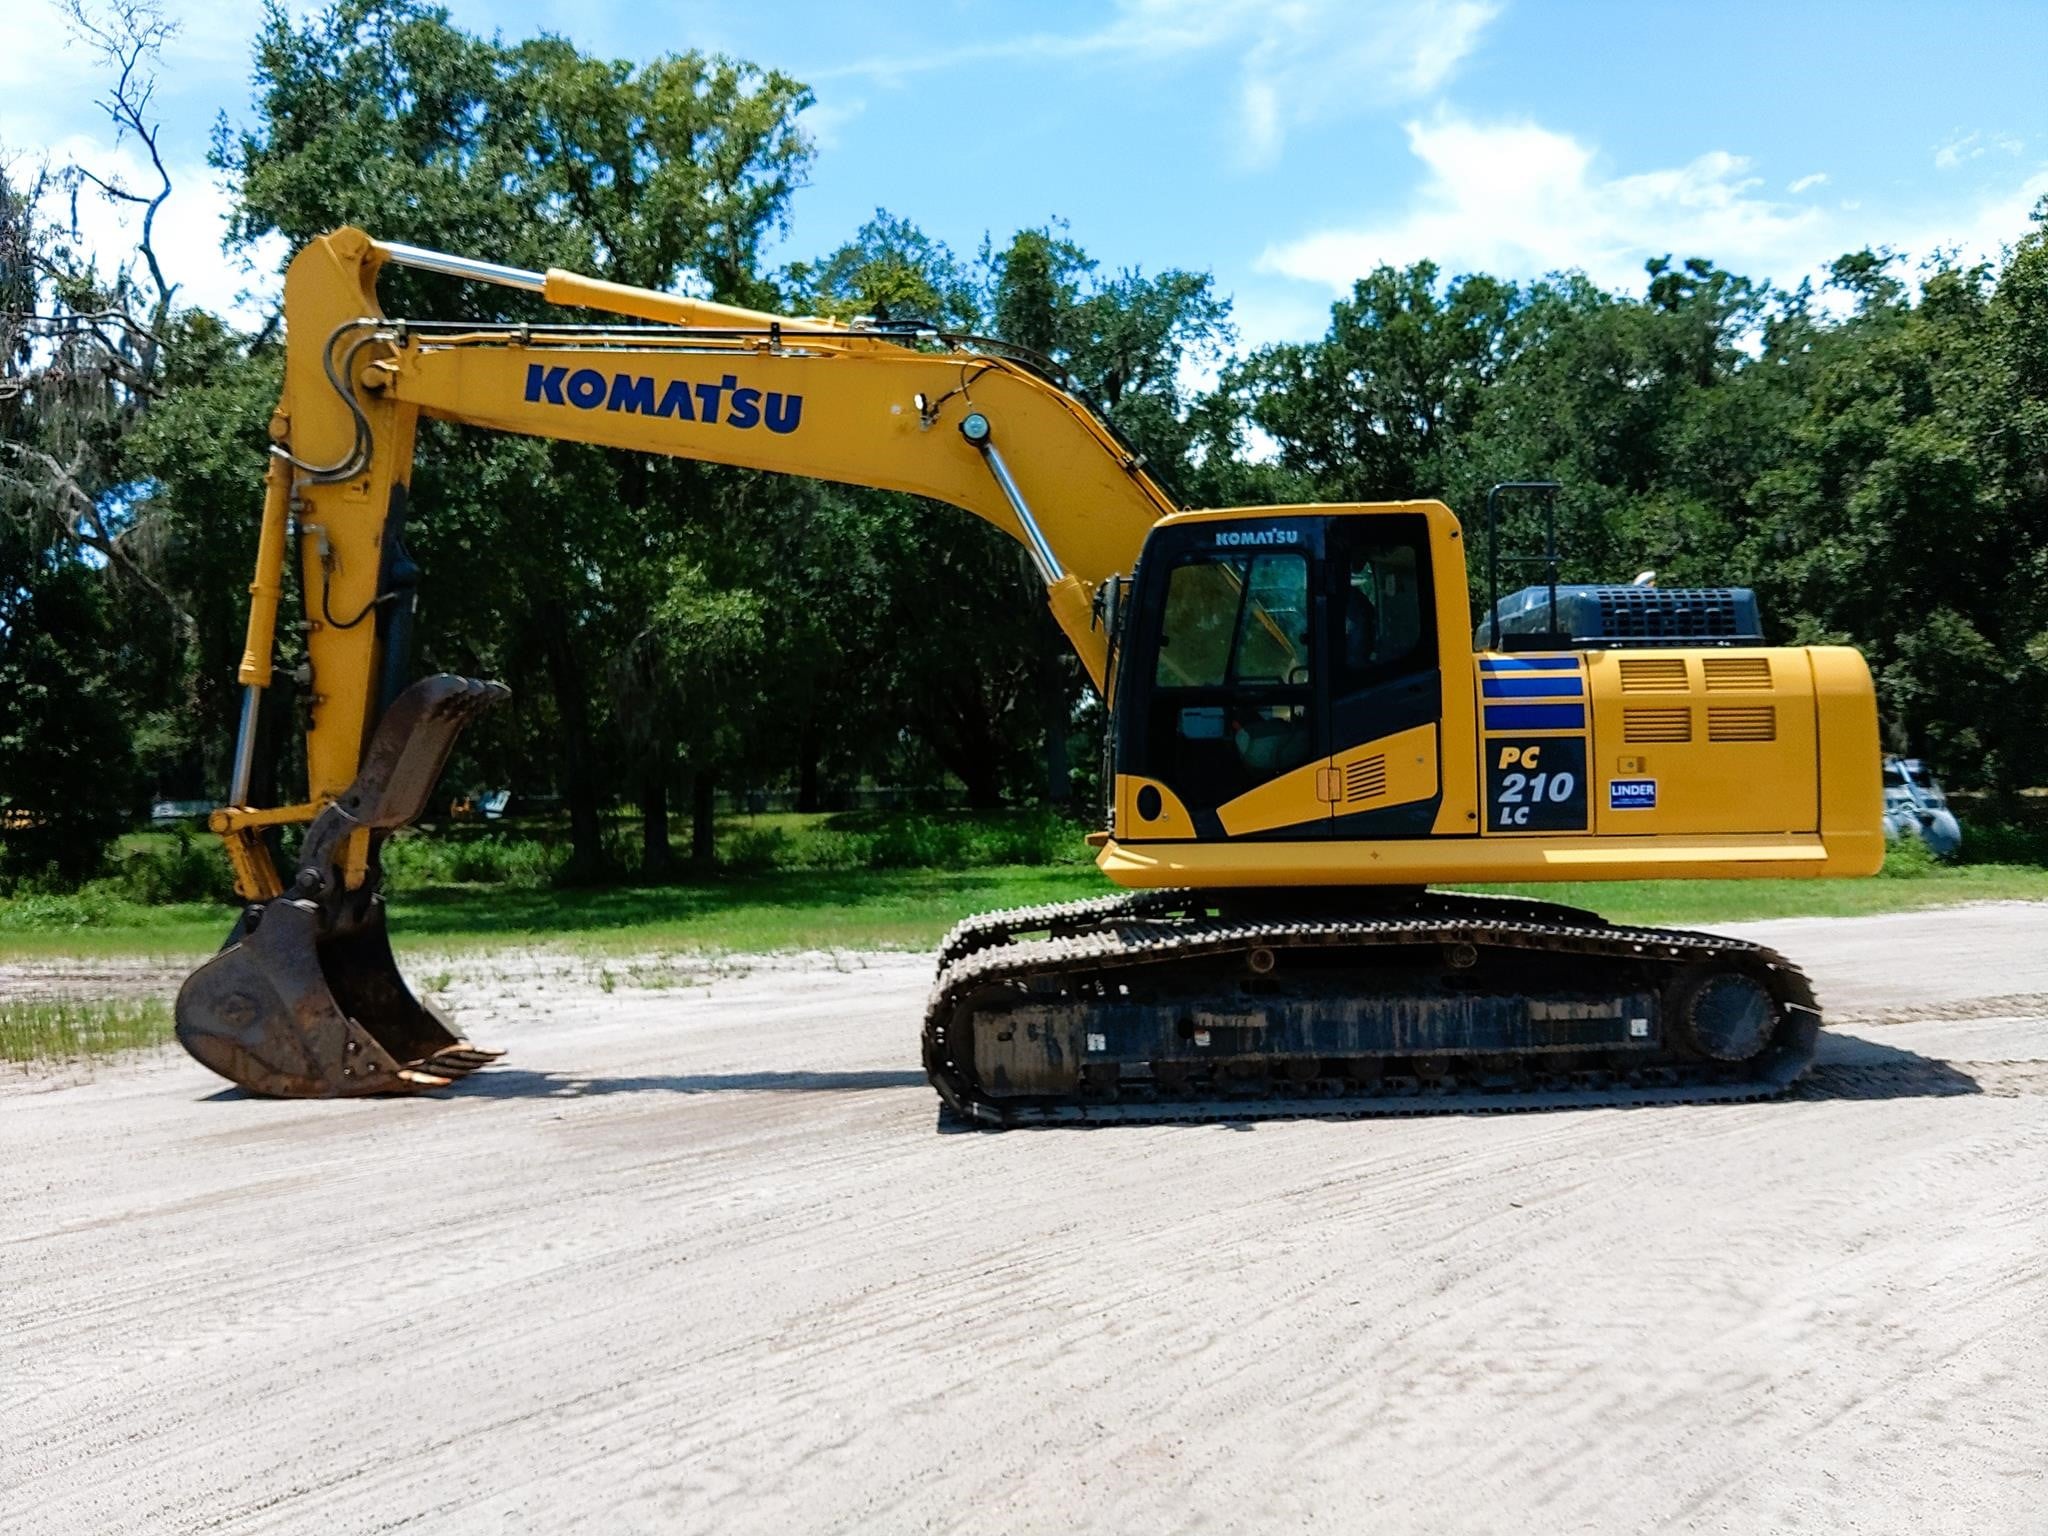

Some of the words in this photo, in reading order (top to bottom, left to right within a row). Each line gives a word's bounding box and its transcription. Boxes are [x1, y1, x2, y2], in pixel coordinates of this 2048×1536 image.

[525, 364, 803, 434] KOMATSU
[1216, 528, 1297, 545] KOMATSU
[1498, 746, 1540, 769] PC
[1498, 772, 1574, 803] 210
[1612, 785, 1654, 796] LINDER
[1500, 807, 1530, 825] LC
